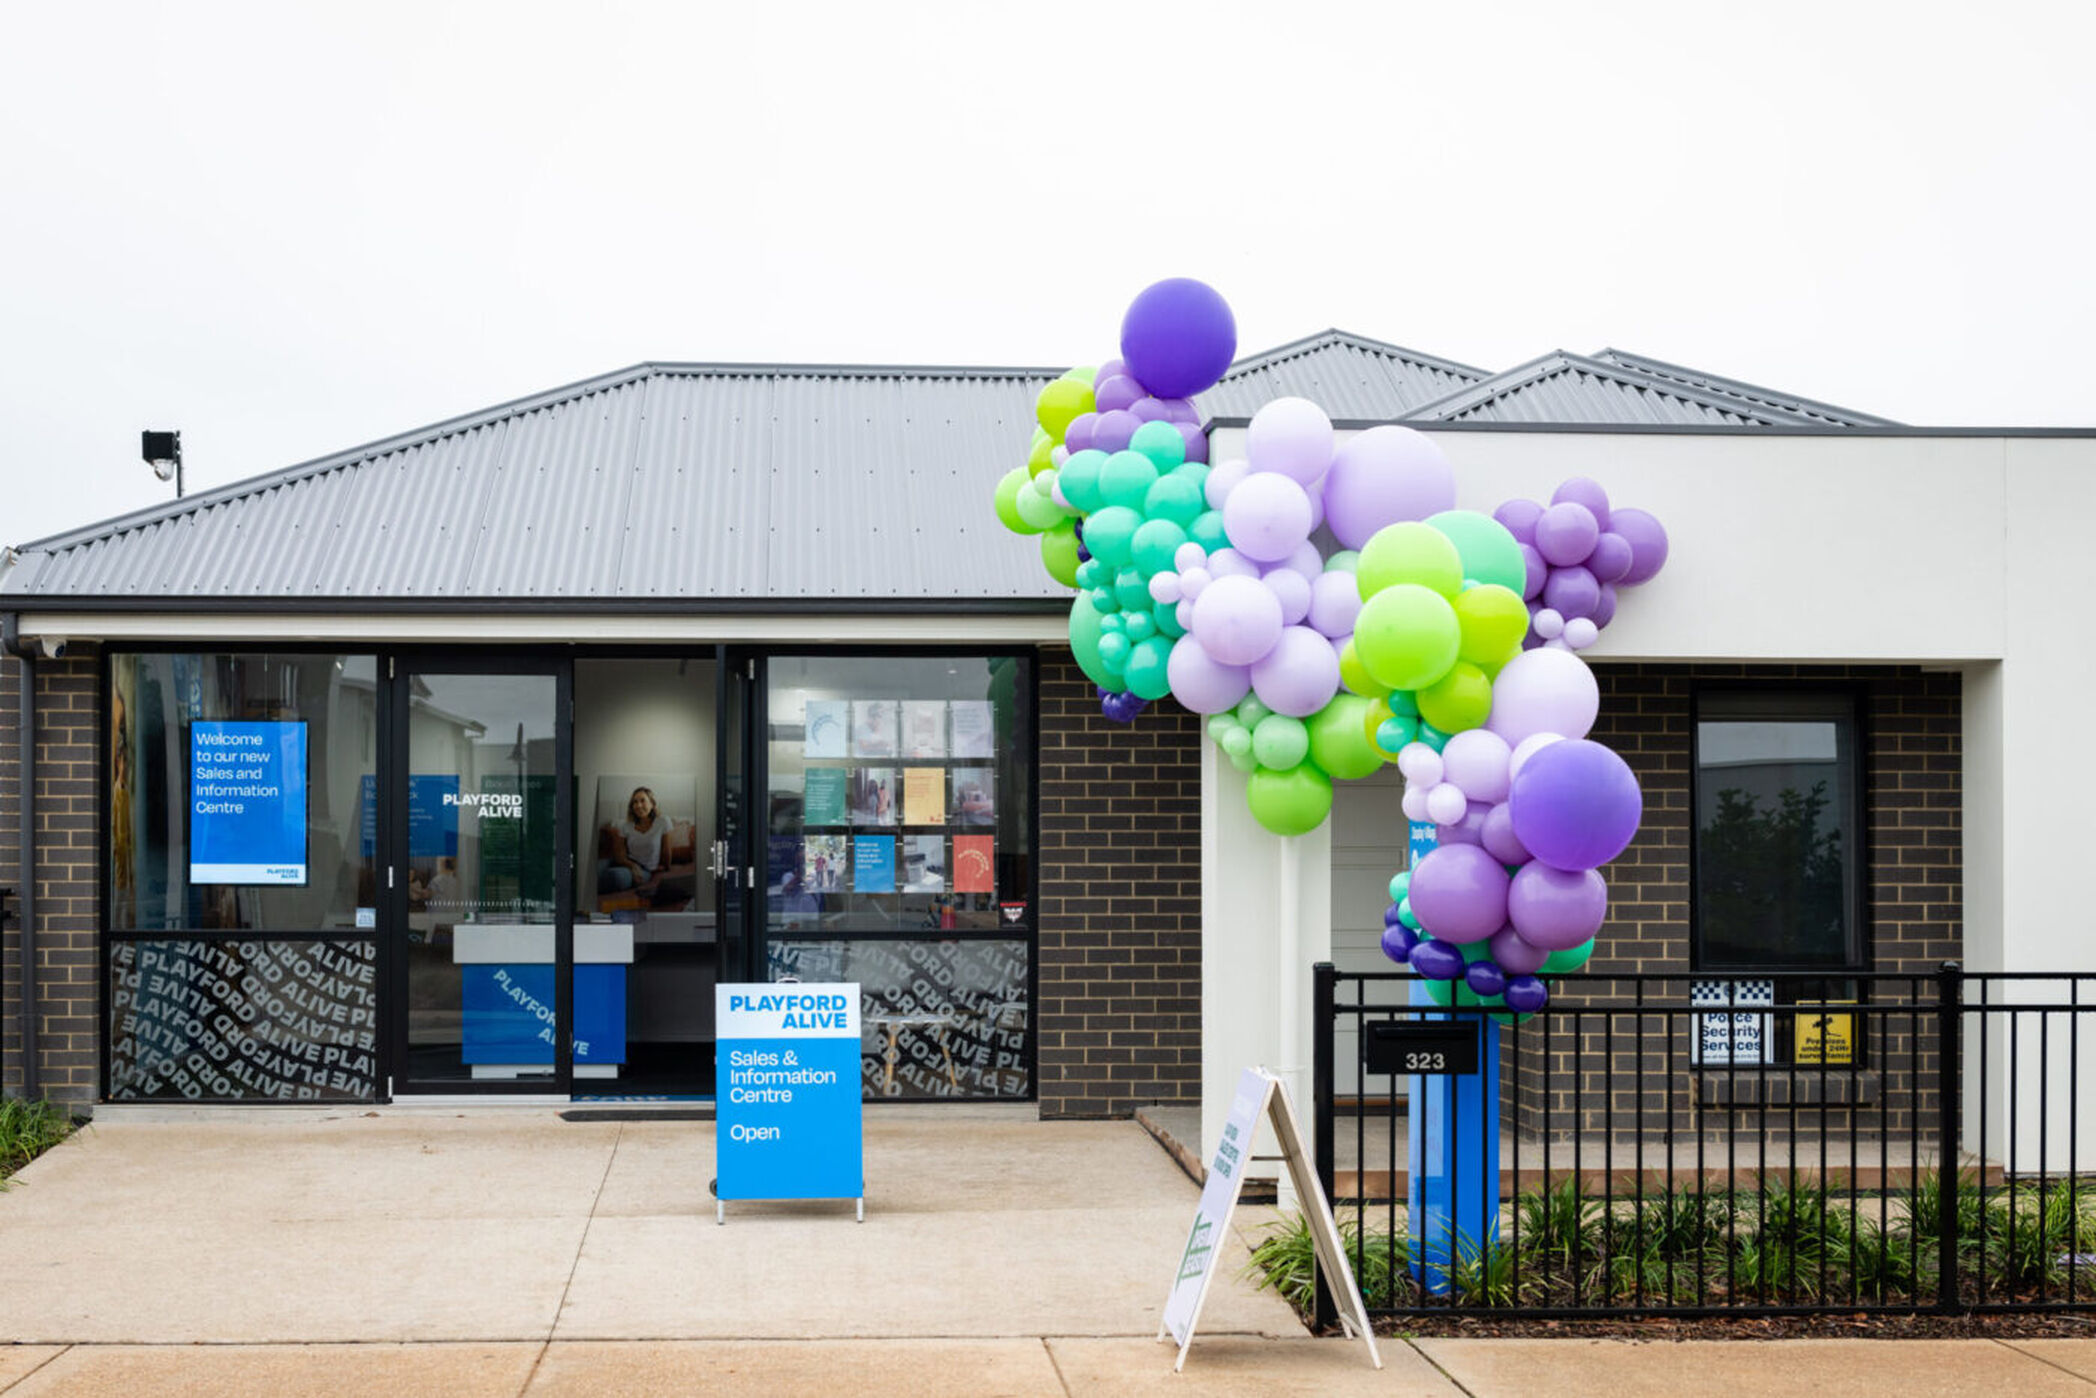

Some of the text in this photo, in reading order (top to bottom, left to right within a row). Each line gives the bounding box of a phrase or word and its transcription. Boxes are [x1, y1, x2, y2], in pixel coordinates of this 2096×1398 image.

[196, 733, 263, 746] Welcome
[196, 752, 270, 763] to our new
[196, 767, 262, 780] Sales and
[196, 784, 278, 797] Information
[443, 794, 522, 806] PLAYFORD
[195, 801, 244, 815] Centre
[478, 806, 522, 818] ALIVE
[142, 952, 256, 1022] PLAYFORD
[254, 1019, 321, 1063] ALIVE
[281, 981, 349, 1022] ALIVE
[730, 995, 847, 1012] PLAYFORD
[781, 1013, 847, 1029] ALIVE
[1708, 1013, 1753, 1022] Poce
[1702, 1025, 1760, 1039] Secrity
[114, 991, 230, 1061] PLAYFORD
[226, 1059, 294, 1099] ALIVE
[1702, 1040, 1760, 1050] Servces
[730, 1050, 799, 1066] Sales &
[1406, 1053, 1445, 1069] 323
[730, 1068, 836, 1084] Information
[730, 1087, 792, 1103] Centre
[730, 1124, 780, 1142] Open
